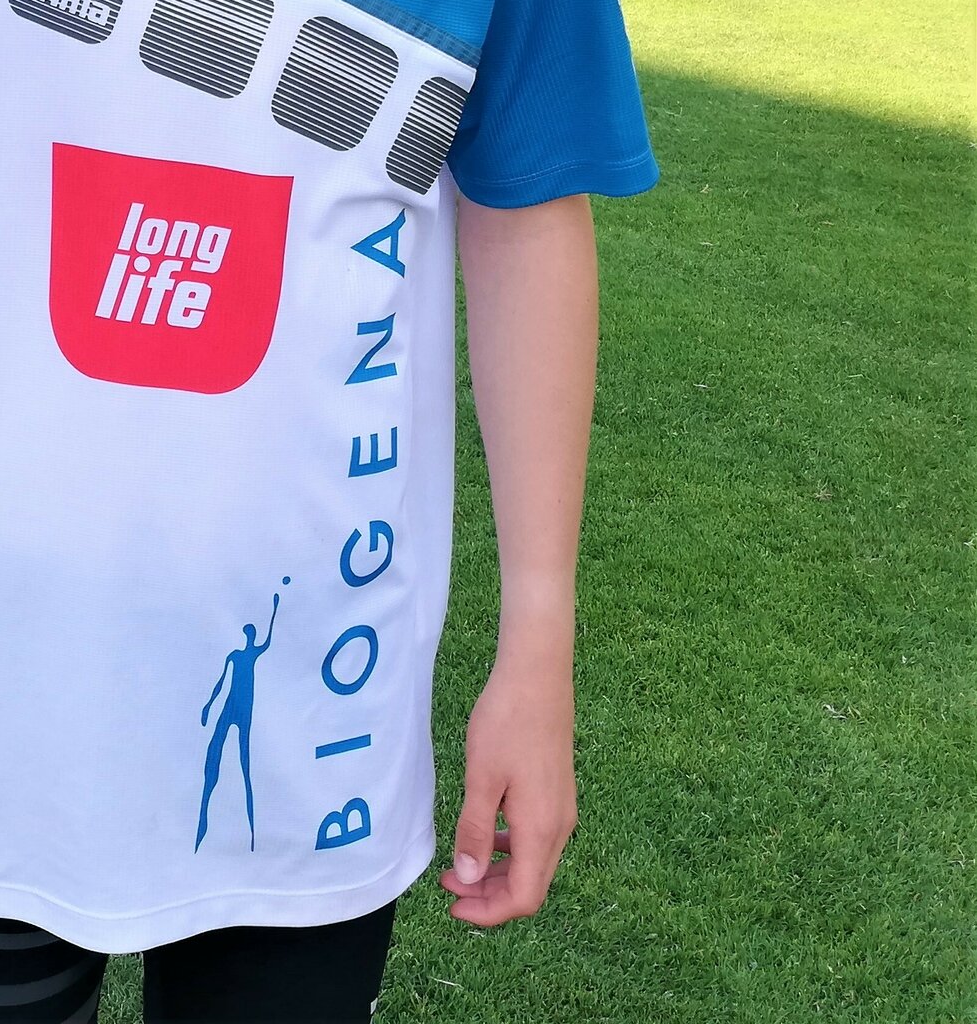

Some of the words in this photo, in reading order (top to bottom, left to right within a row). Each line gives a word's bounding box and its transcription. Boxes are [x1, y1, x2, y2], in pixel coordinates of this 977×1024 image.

[117, 202, 232, 274] long
[94, 253, 212, 329] life
[315, 208, 406, 851] BIOGENA
